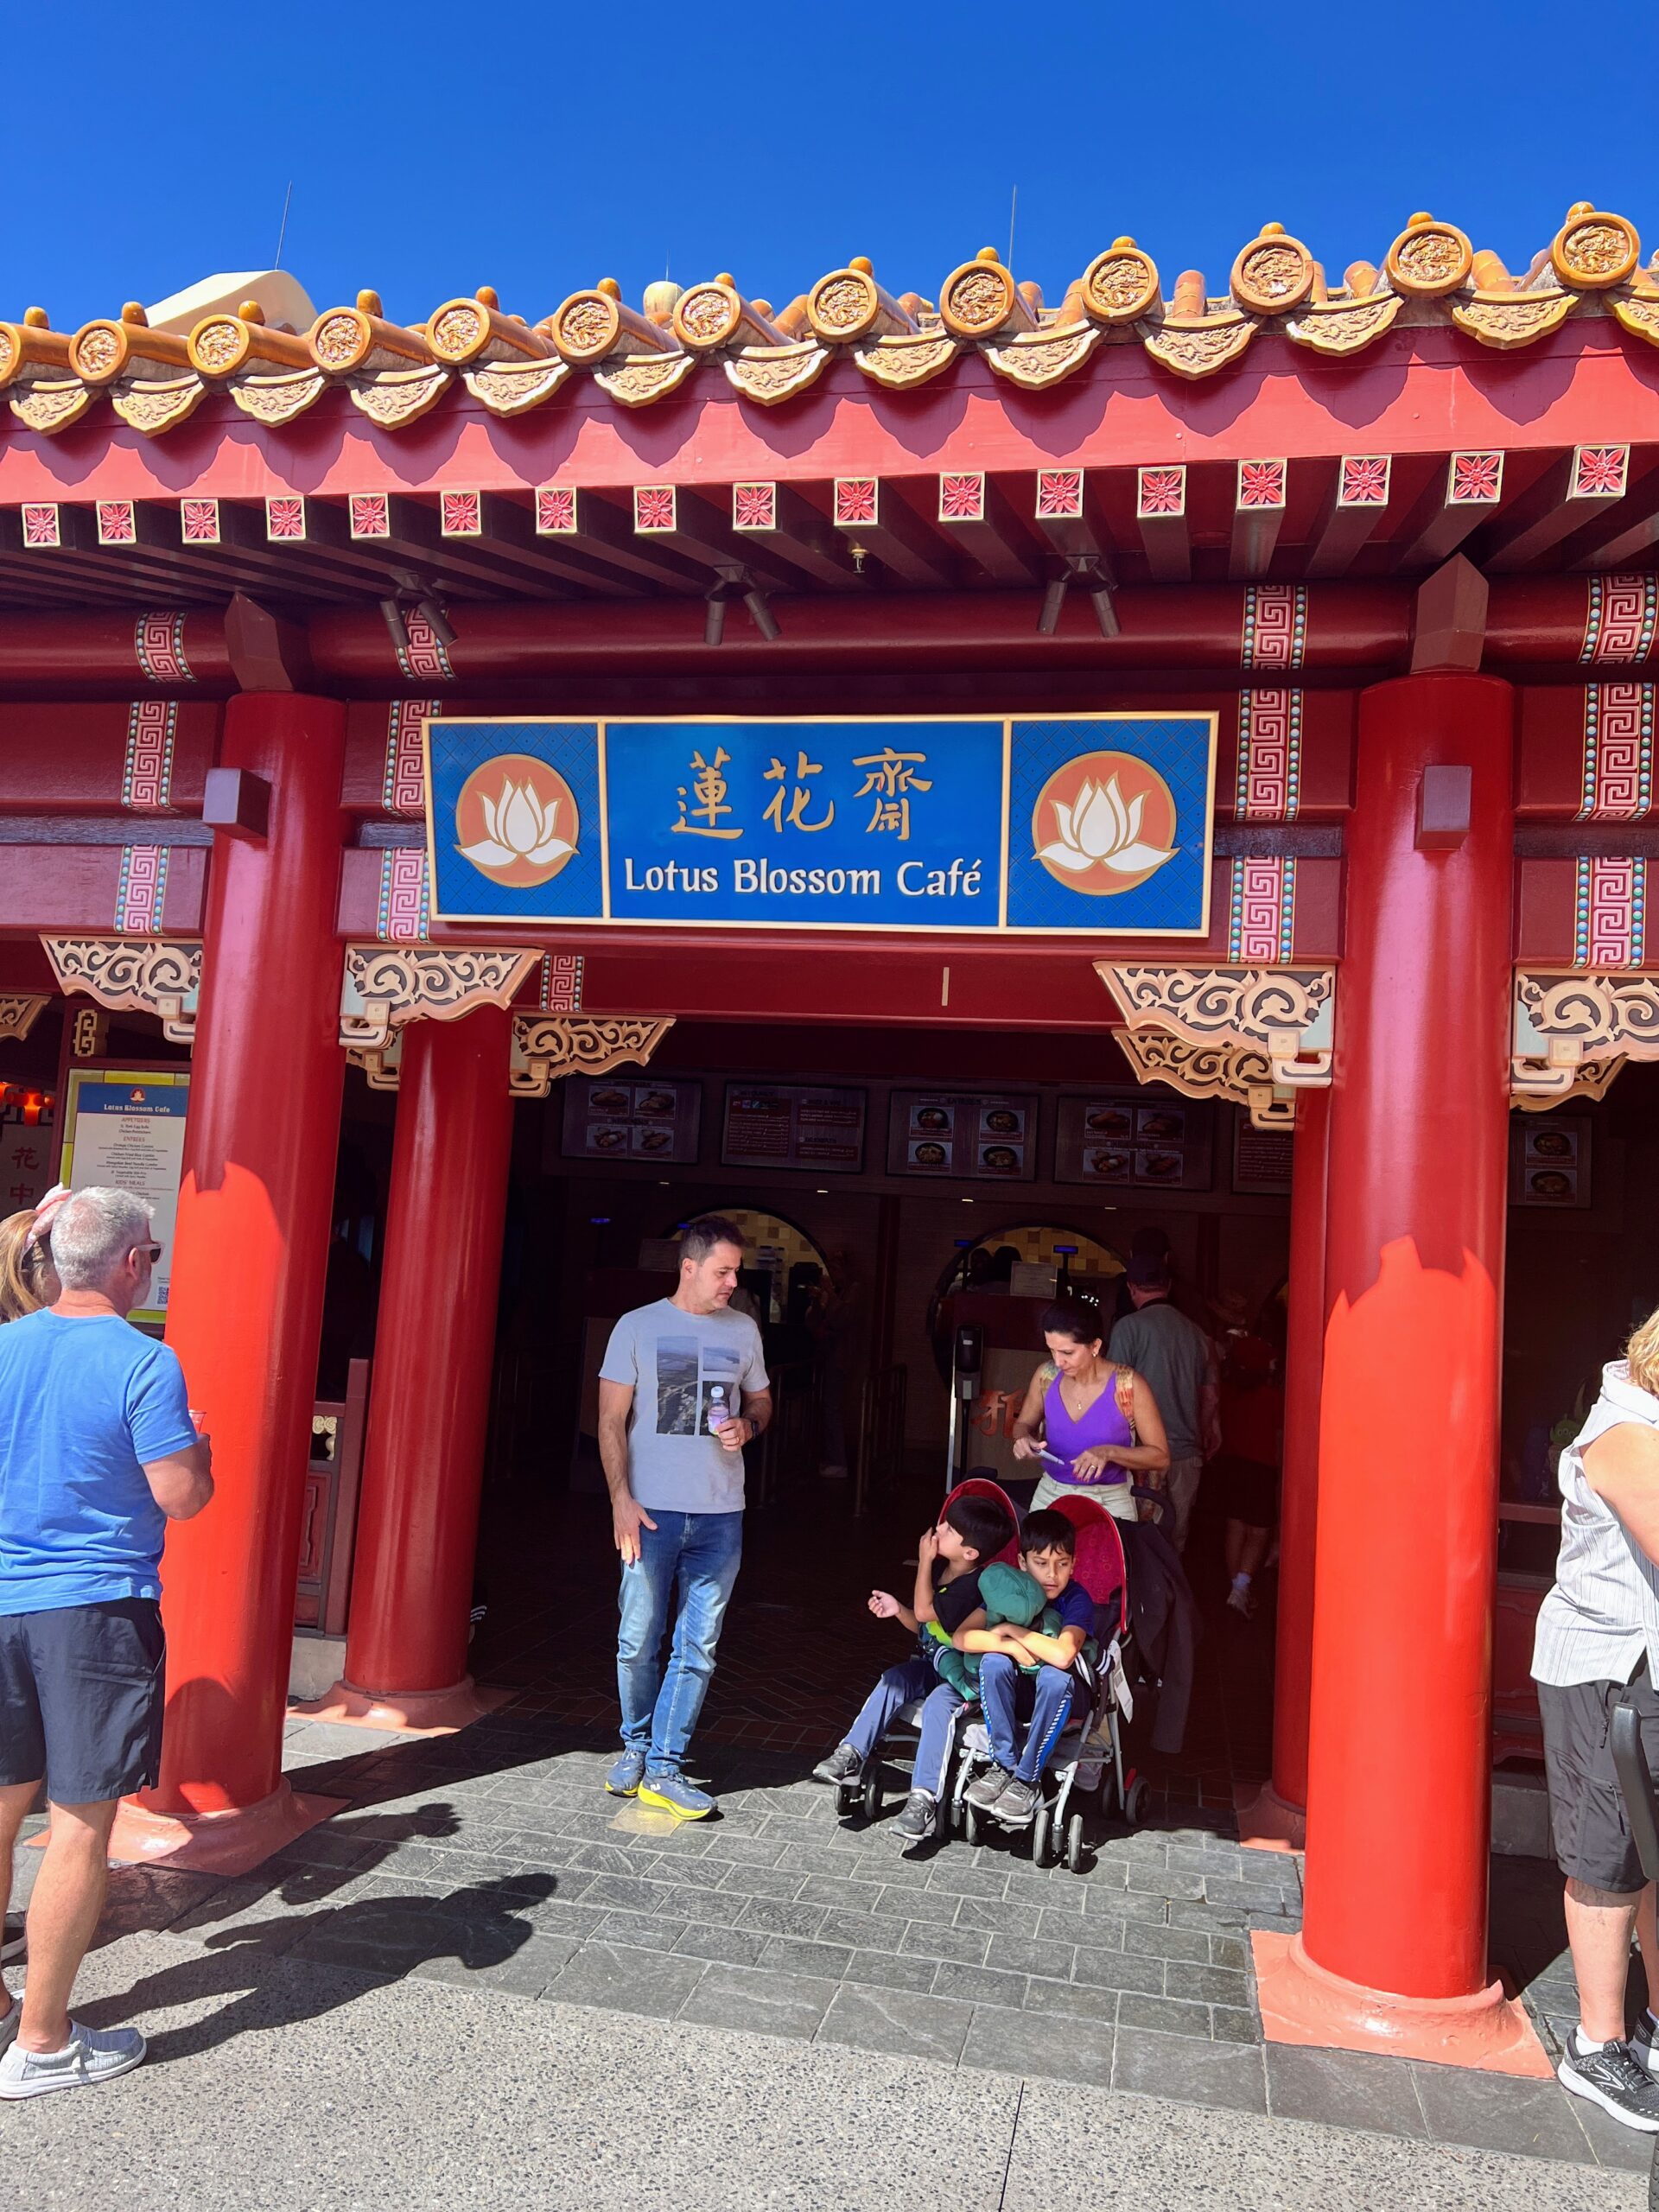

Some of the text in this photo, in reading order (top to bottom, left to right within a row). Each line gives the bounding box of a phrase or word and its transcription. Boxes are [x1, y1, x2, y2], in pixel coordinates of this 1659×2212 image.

[624, 857, 983, 897] Lotus Blossom Café
